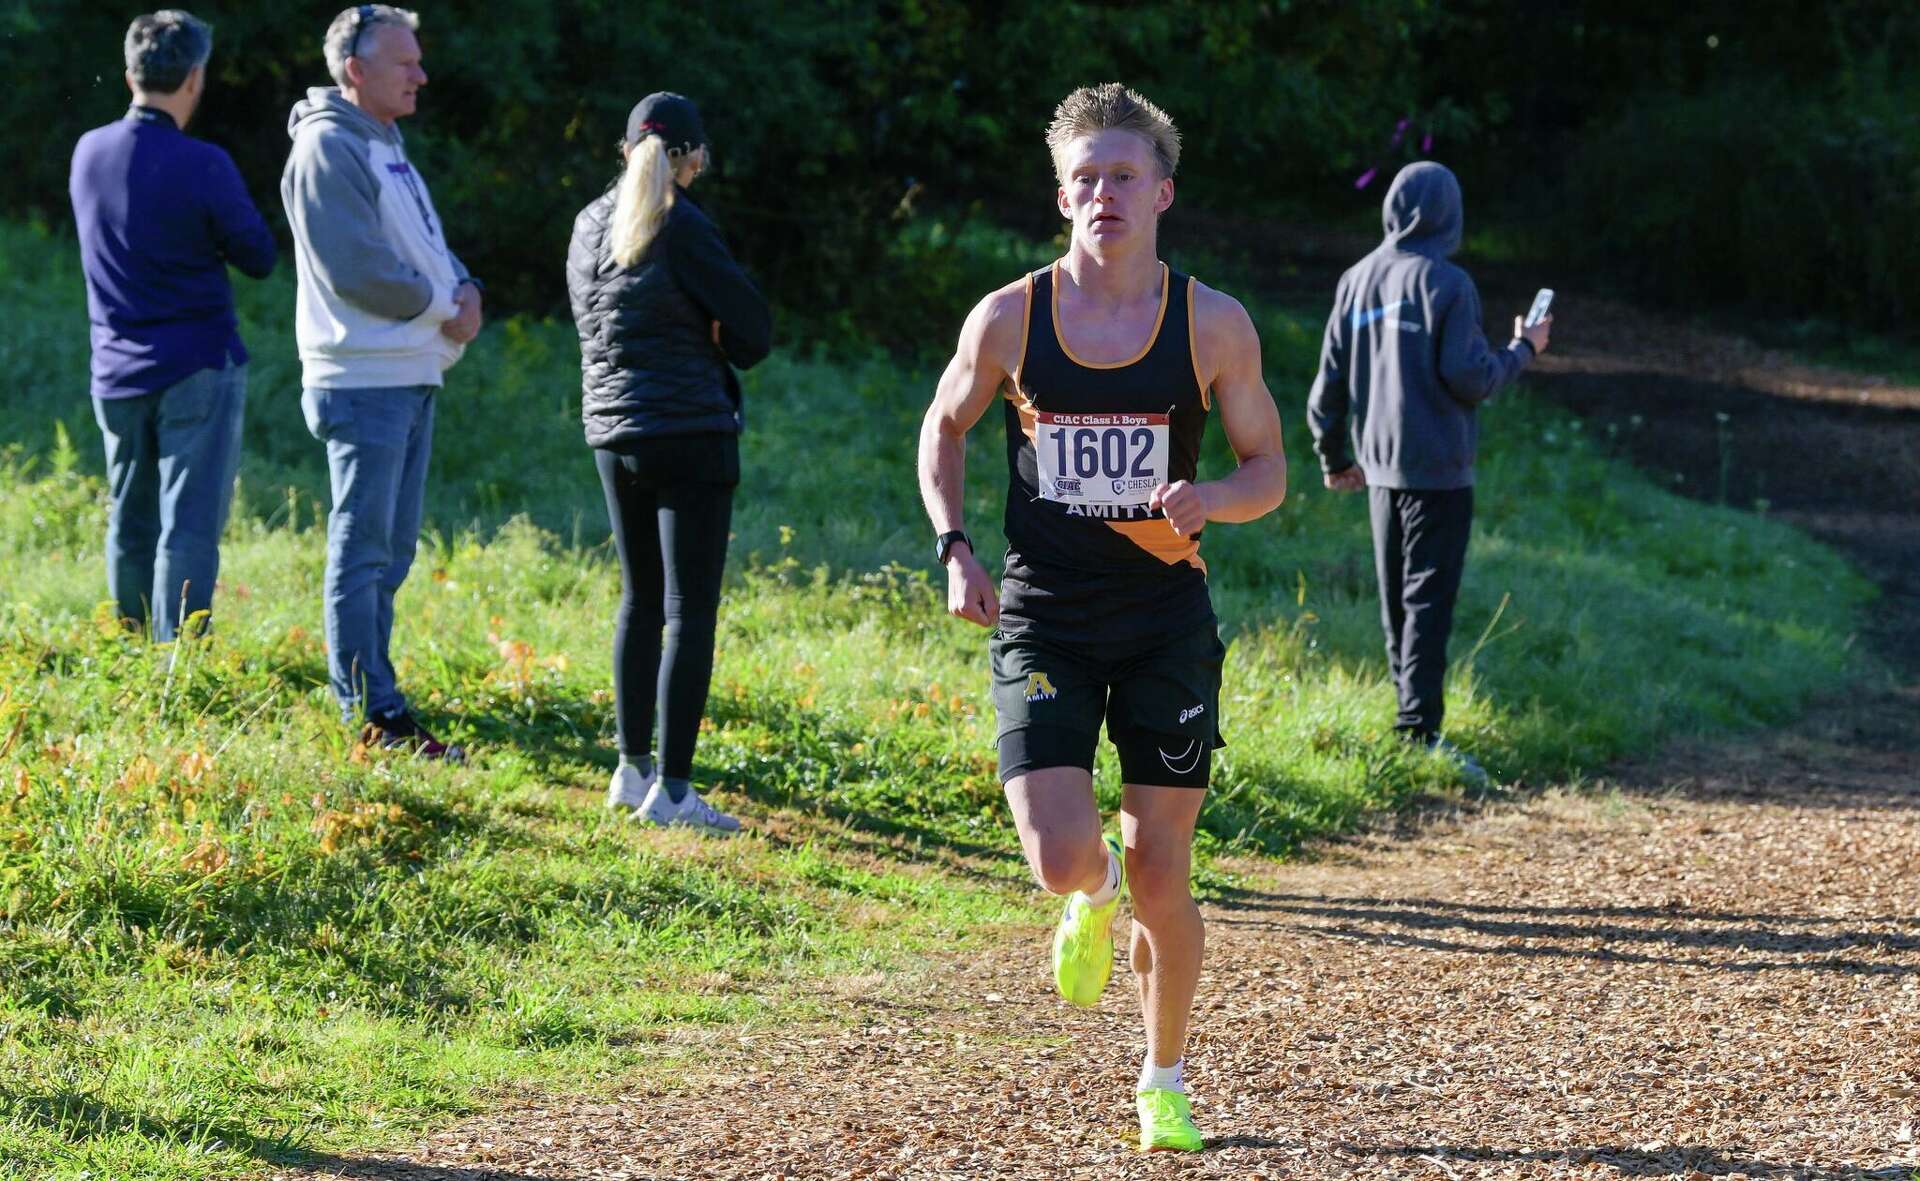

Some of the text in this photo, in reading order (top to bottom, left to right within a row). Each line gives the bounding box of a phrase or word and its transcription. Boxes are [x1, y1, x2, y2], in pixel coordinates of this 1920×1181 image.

[1053, 415, 1148, 426] CIAC Class L Boys
[1050, 427, 1155, 479] 1602
[1066, 503, 1153, 519] AMITY
[1026, 691, 1057, 703] AMITY
